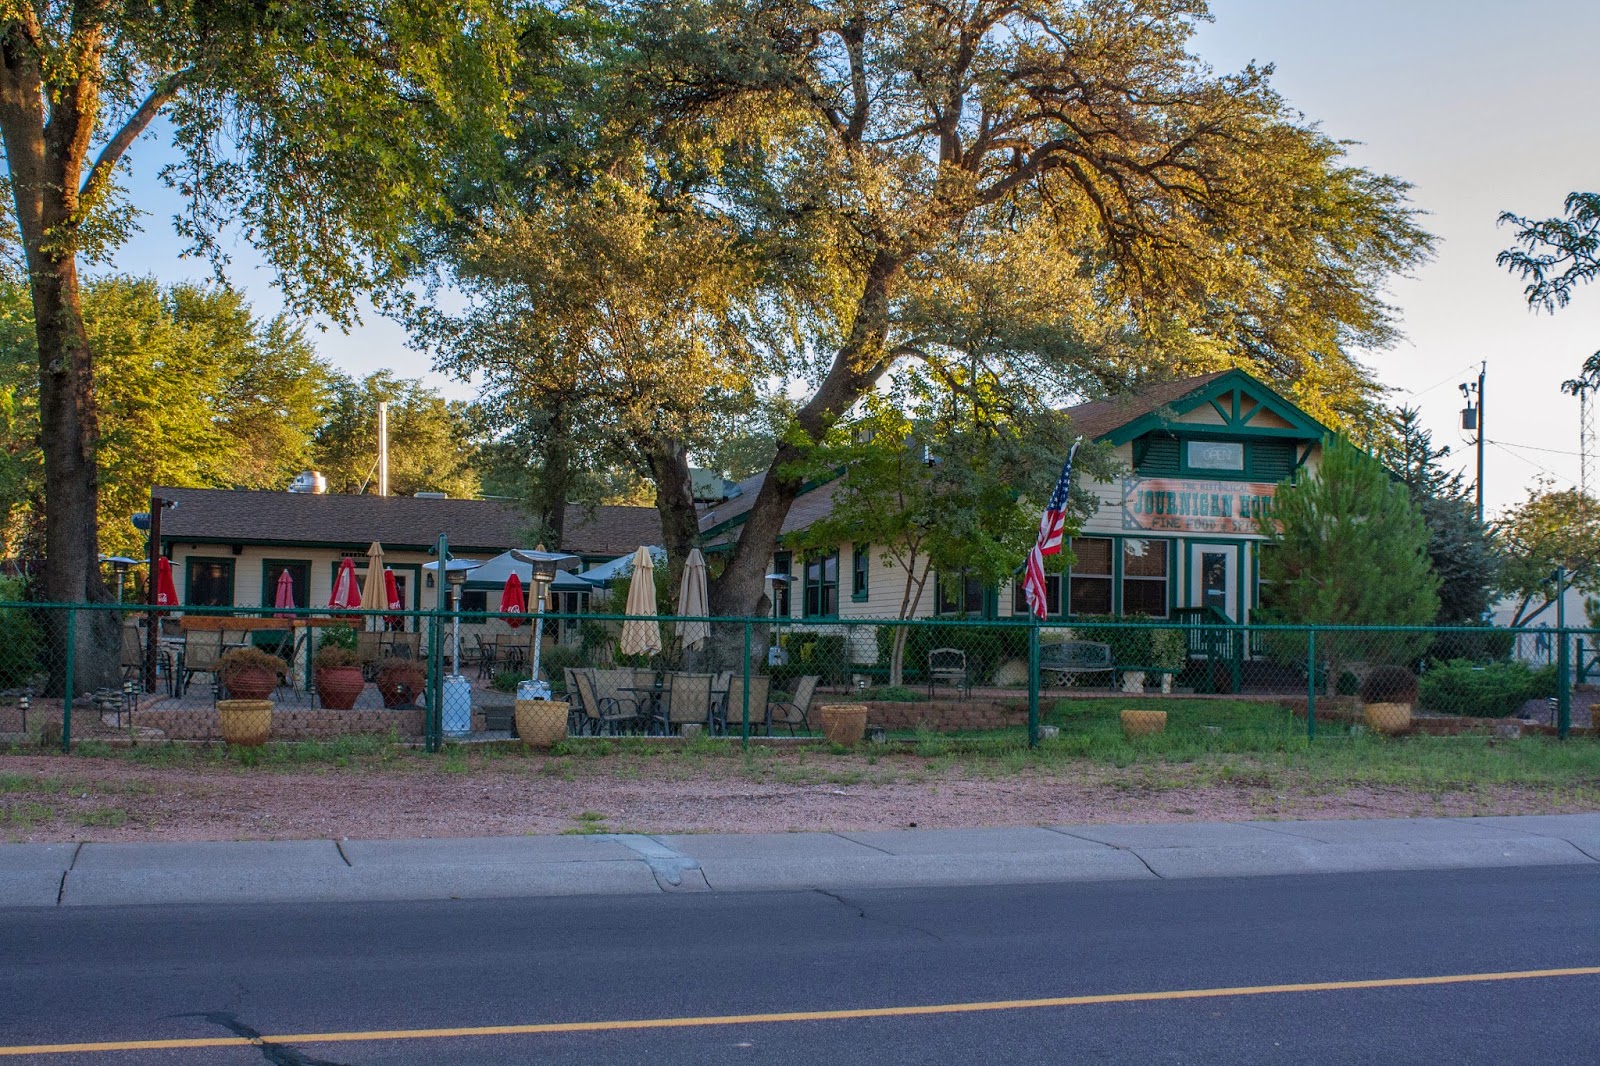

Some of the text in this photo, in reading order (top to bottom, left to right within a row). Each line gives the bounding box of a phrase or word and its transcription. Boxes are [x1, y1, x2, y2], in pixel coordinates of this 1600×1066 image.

[1203, 448, 1232, 461] OPEN
[1134, 490, 1233, 517] JOURNIGAN
[1152, 516, 1180, 528] FINE
[1186, 517, 1216, 530] FOOD
